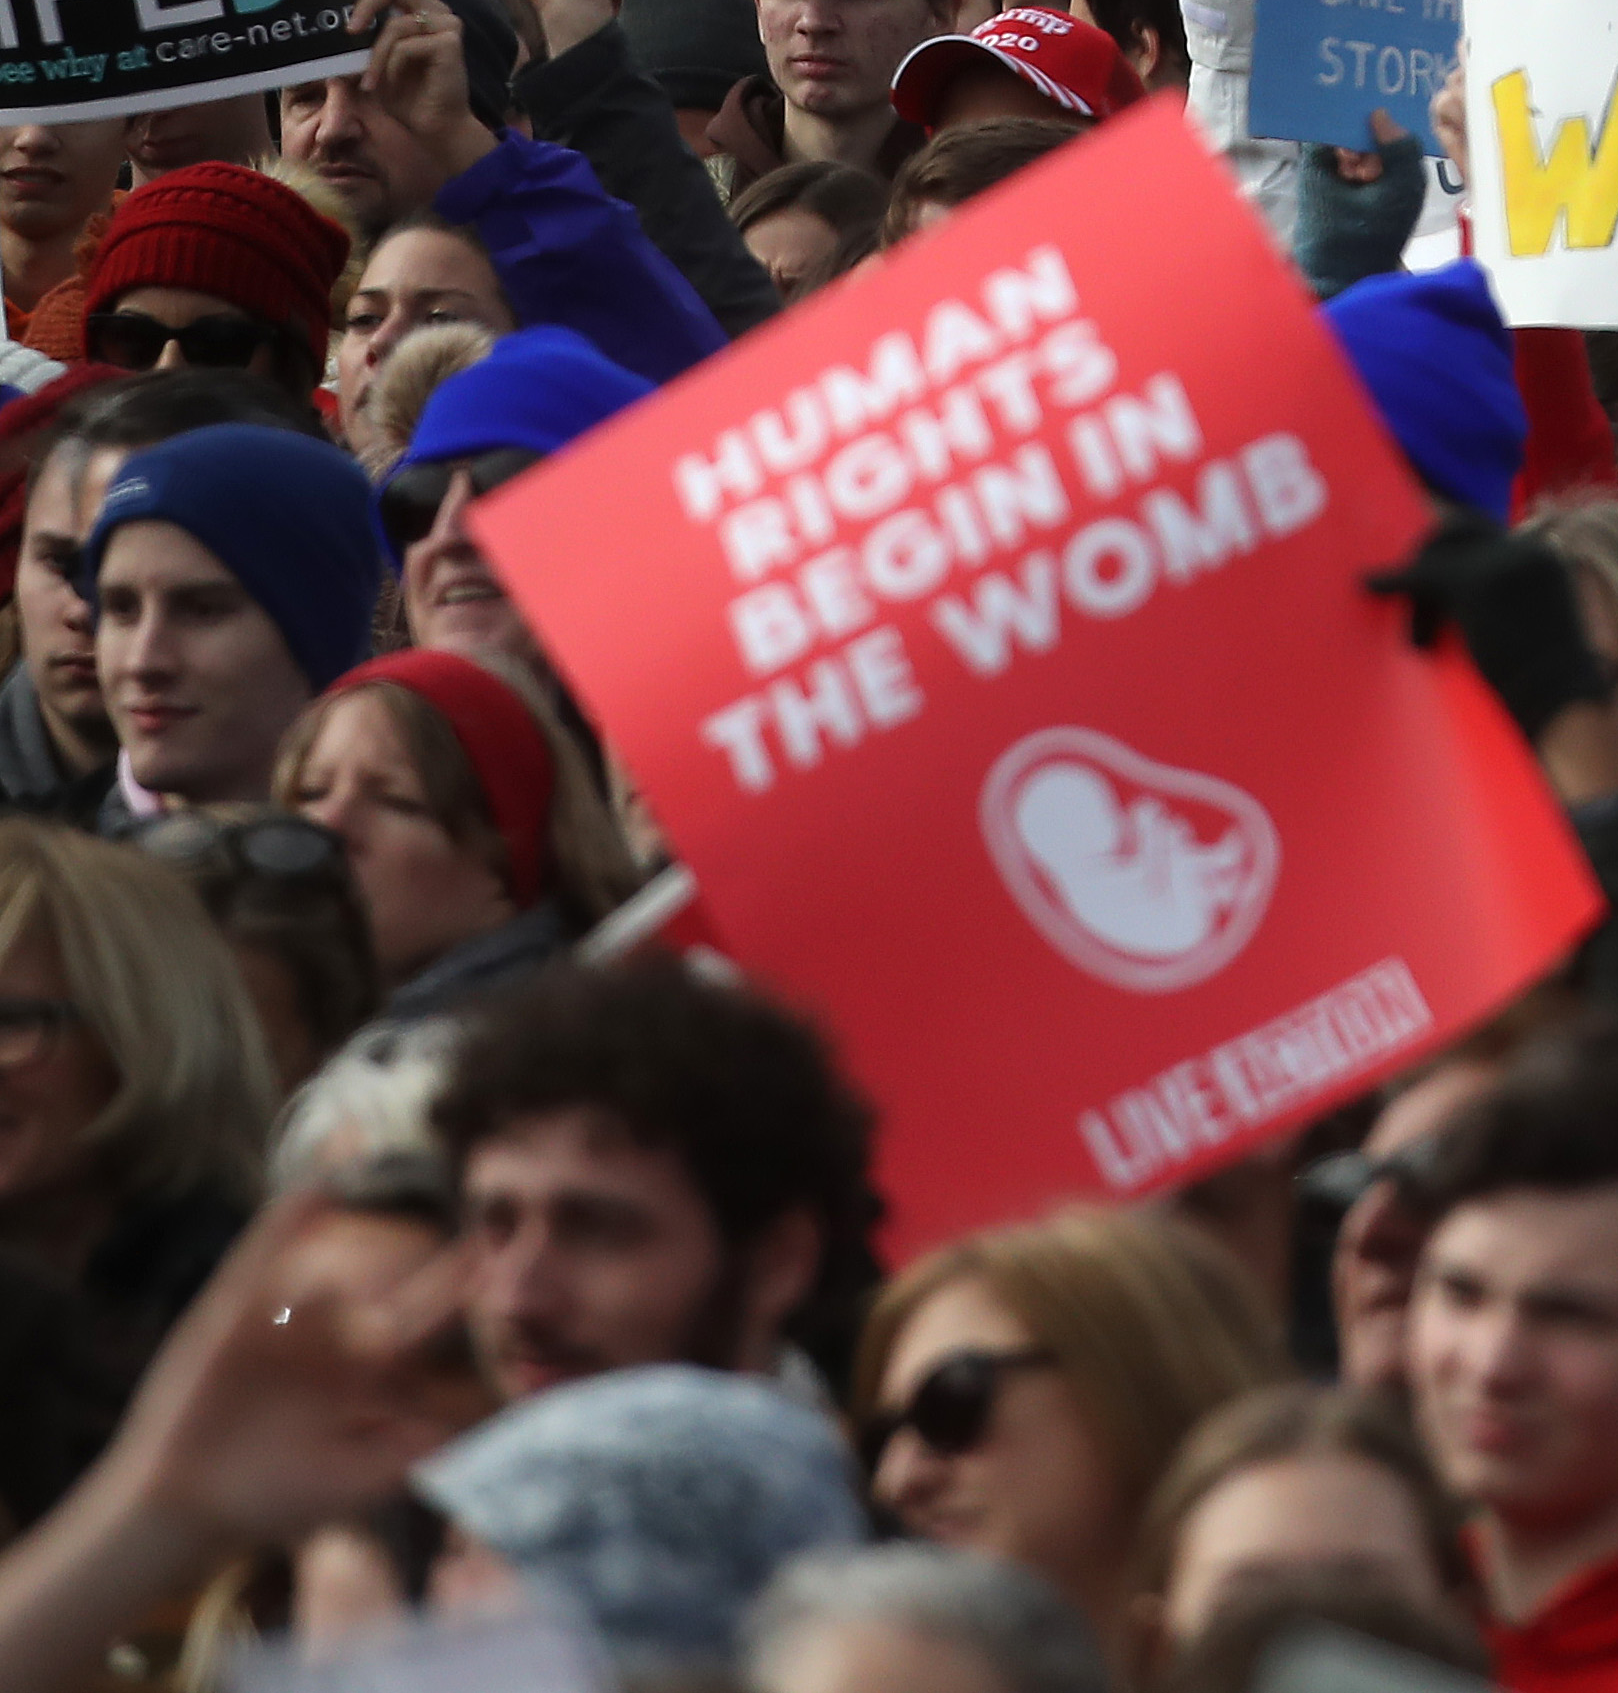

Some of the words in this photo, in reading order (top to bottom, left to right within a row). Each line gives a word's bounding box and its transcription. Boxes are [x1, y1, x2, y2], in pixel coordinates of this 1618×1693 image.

[0, 58, 37, 84] ee
[154, 4, 378, 64] care-net.or
[980, 32, 1040, 52] 020
[675, 243, 1082, 522] HUMAN
[718, 315, 1120, 583] RIGHTS
[698, 625, 926, 795] THE
[930, 427, 1330, 679] WOMB
[726, 440, 1074, 677] BEGIN
[1064, 369, 1206, 543] IN
